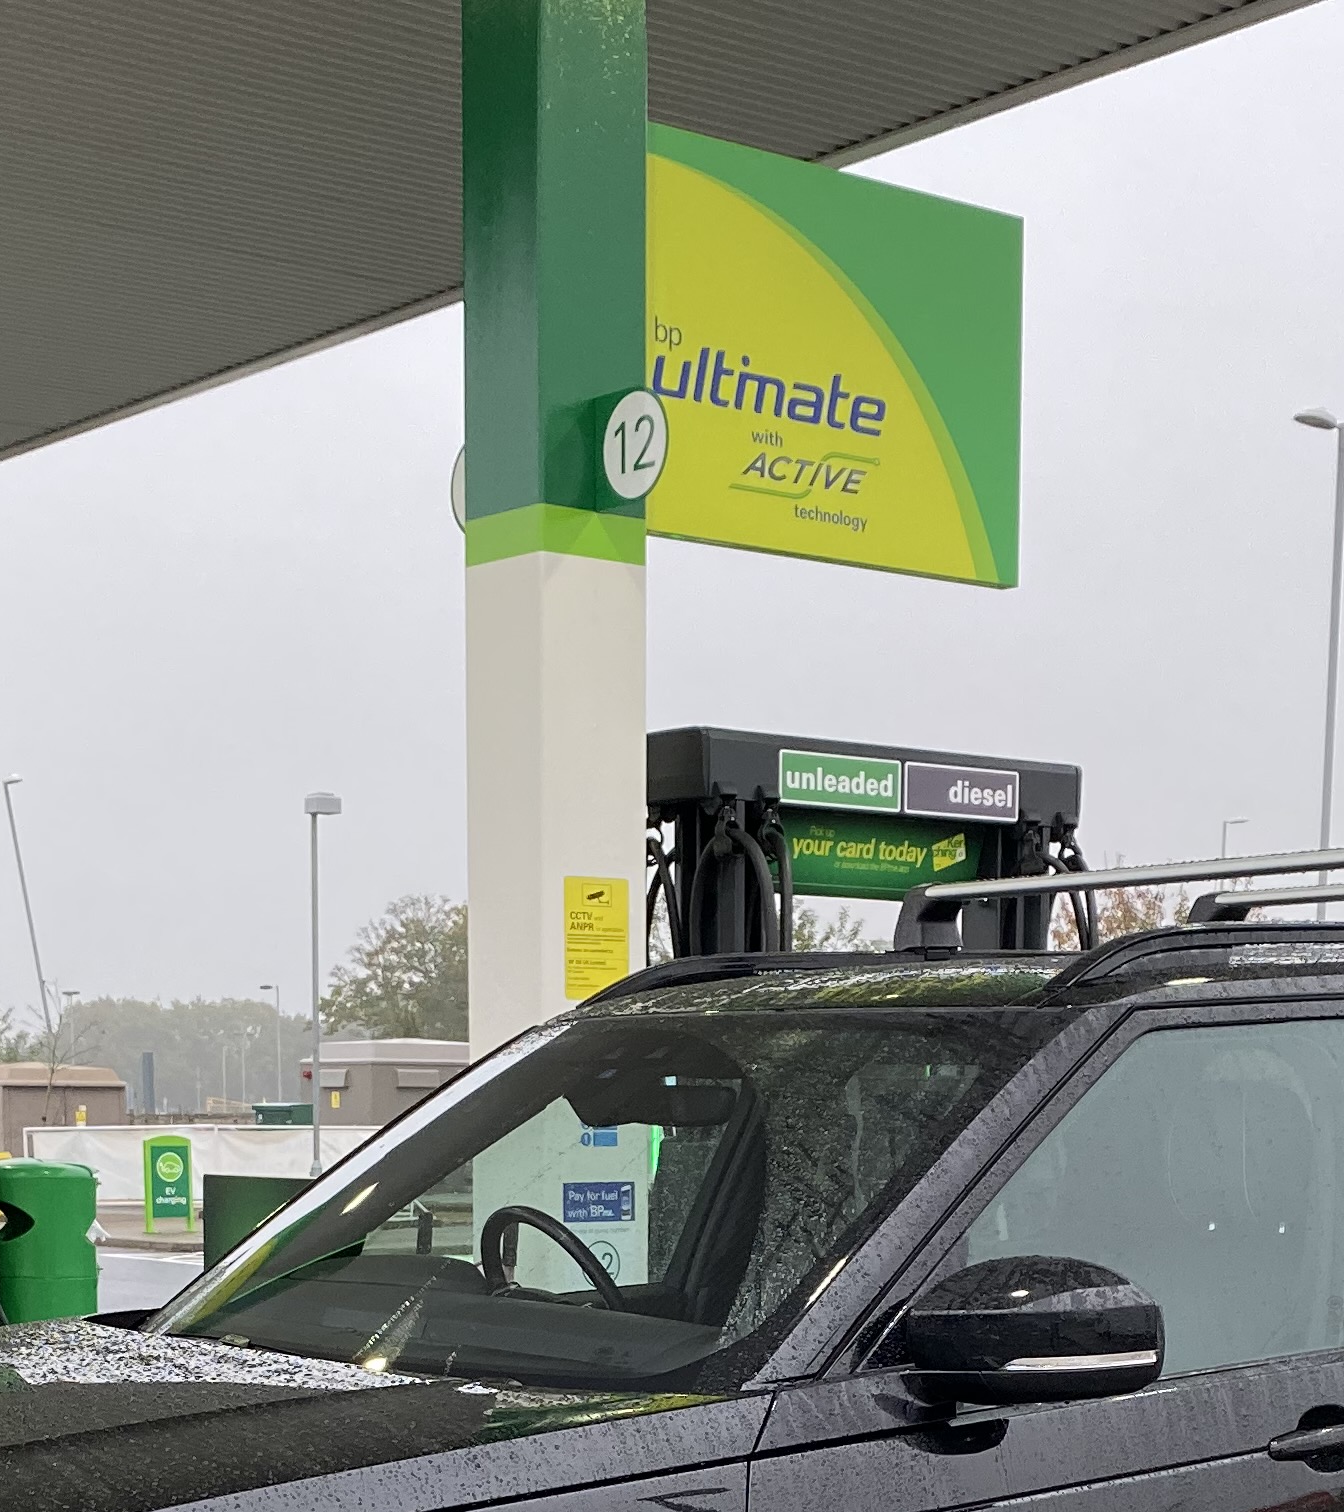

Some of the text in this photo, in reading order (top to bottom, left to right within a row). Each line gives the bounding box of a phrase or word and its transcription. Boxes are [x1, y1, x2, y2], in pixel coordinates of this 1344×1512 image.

[654, 316, 682, 350] bp
[652, 347, 886, 437] ultimate
[612, 414, 656, 475] 12
[751, 430, 783, 447] with
[742, 452, 867, 494] ACTIVE
[794, 504, 868, 532] technology
[786, 767, 1013, 808] unleaded diesel
[792, 837, 927, 867] your card today
[569, 911, 594, 921] CCTV
[165, 1186, 176, 1196] EV
[568, 1189, 619, 1203] Pay for fuel
